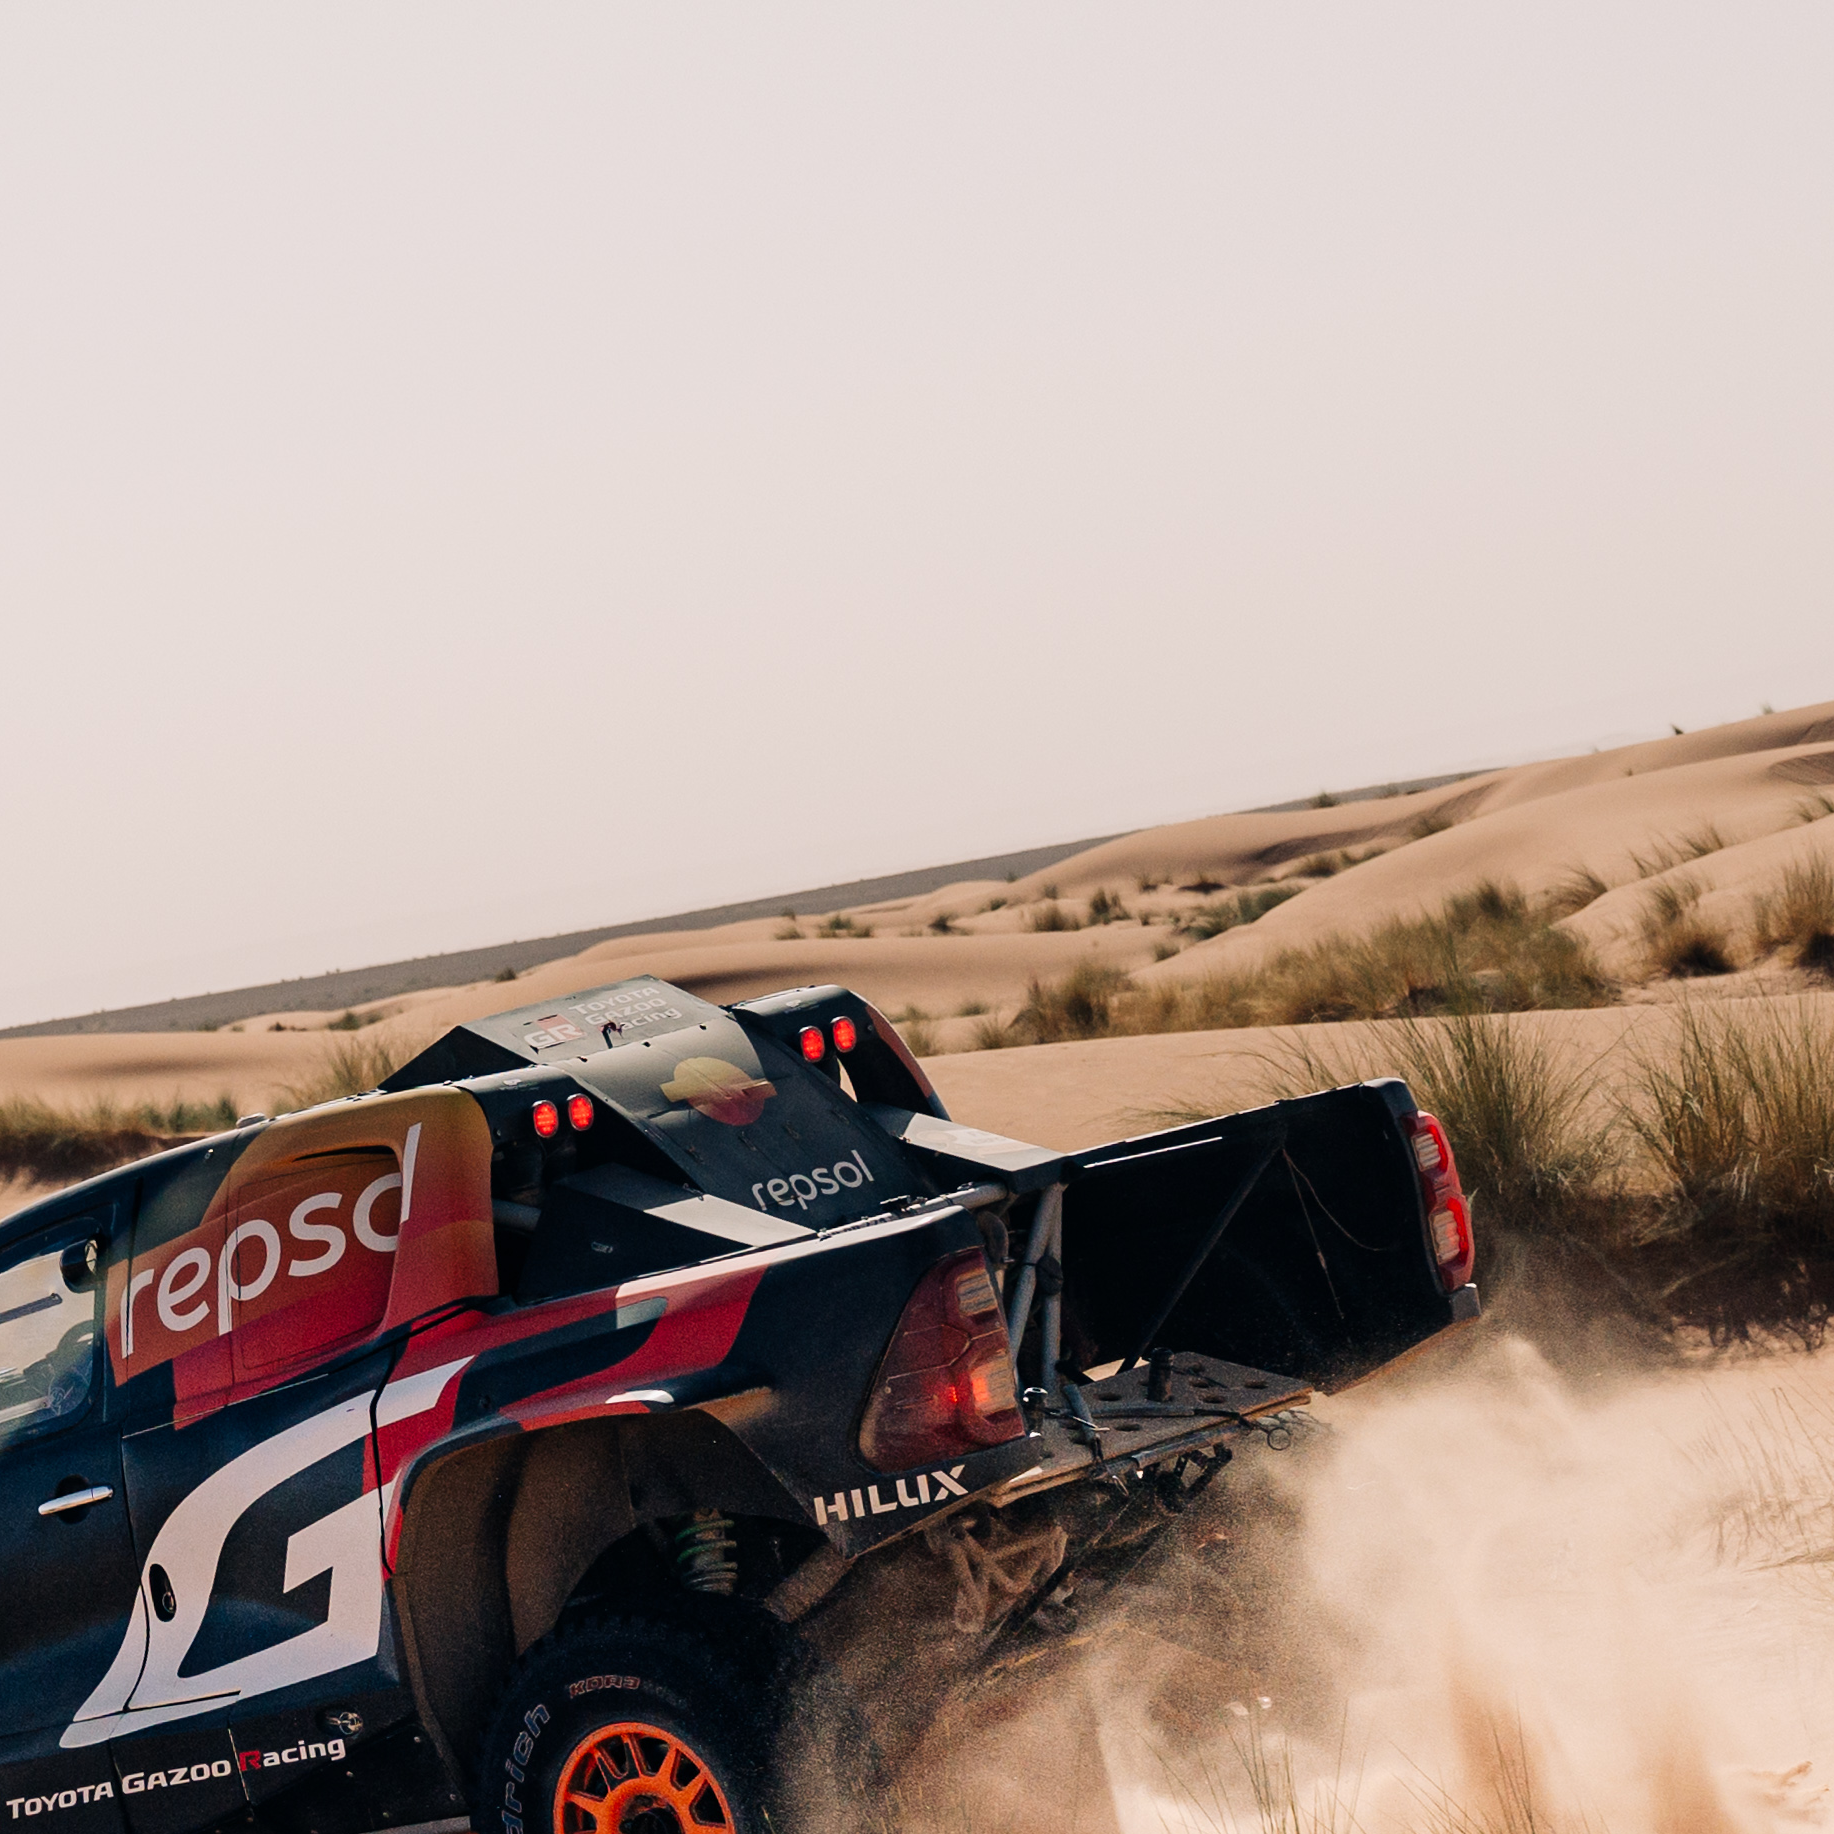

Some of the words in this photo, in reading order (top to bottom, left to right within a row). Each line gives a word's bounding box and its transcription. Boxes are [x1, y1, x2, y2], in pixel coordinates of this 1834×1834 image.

[568, 986, 661, 1015] TOYOTA
[584, 998, 667, 1026] GAZOO
[598, 1007, 683, 1035] acing
[524, 1023, 583, 1049] GR
[751, 1149, 875, 1211] repsol
[120, 1122, 422, 1359] repsol
[814, 1464, 968, 1526] HILUX
[6, 1781, 114, 1820] TOYOTA
[121, 1759, 232, 1795] GAZOO
[239, 1738, 347, 1772] Racing
